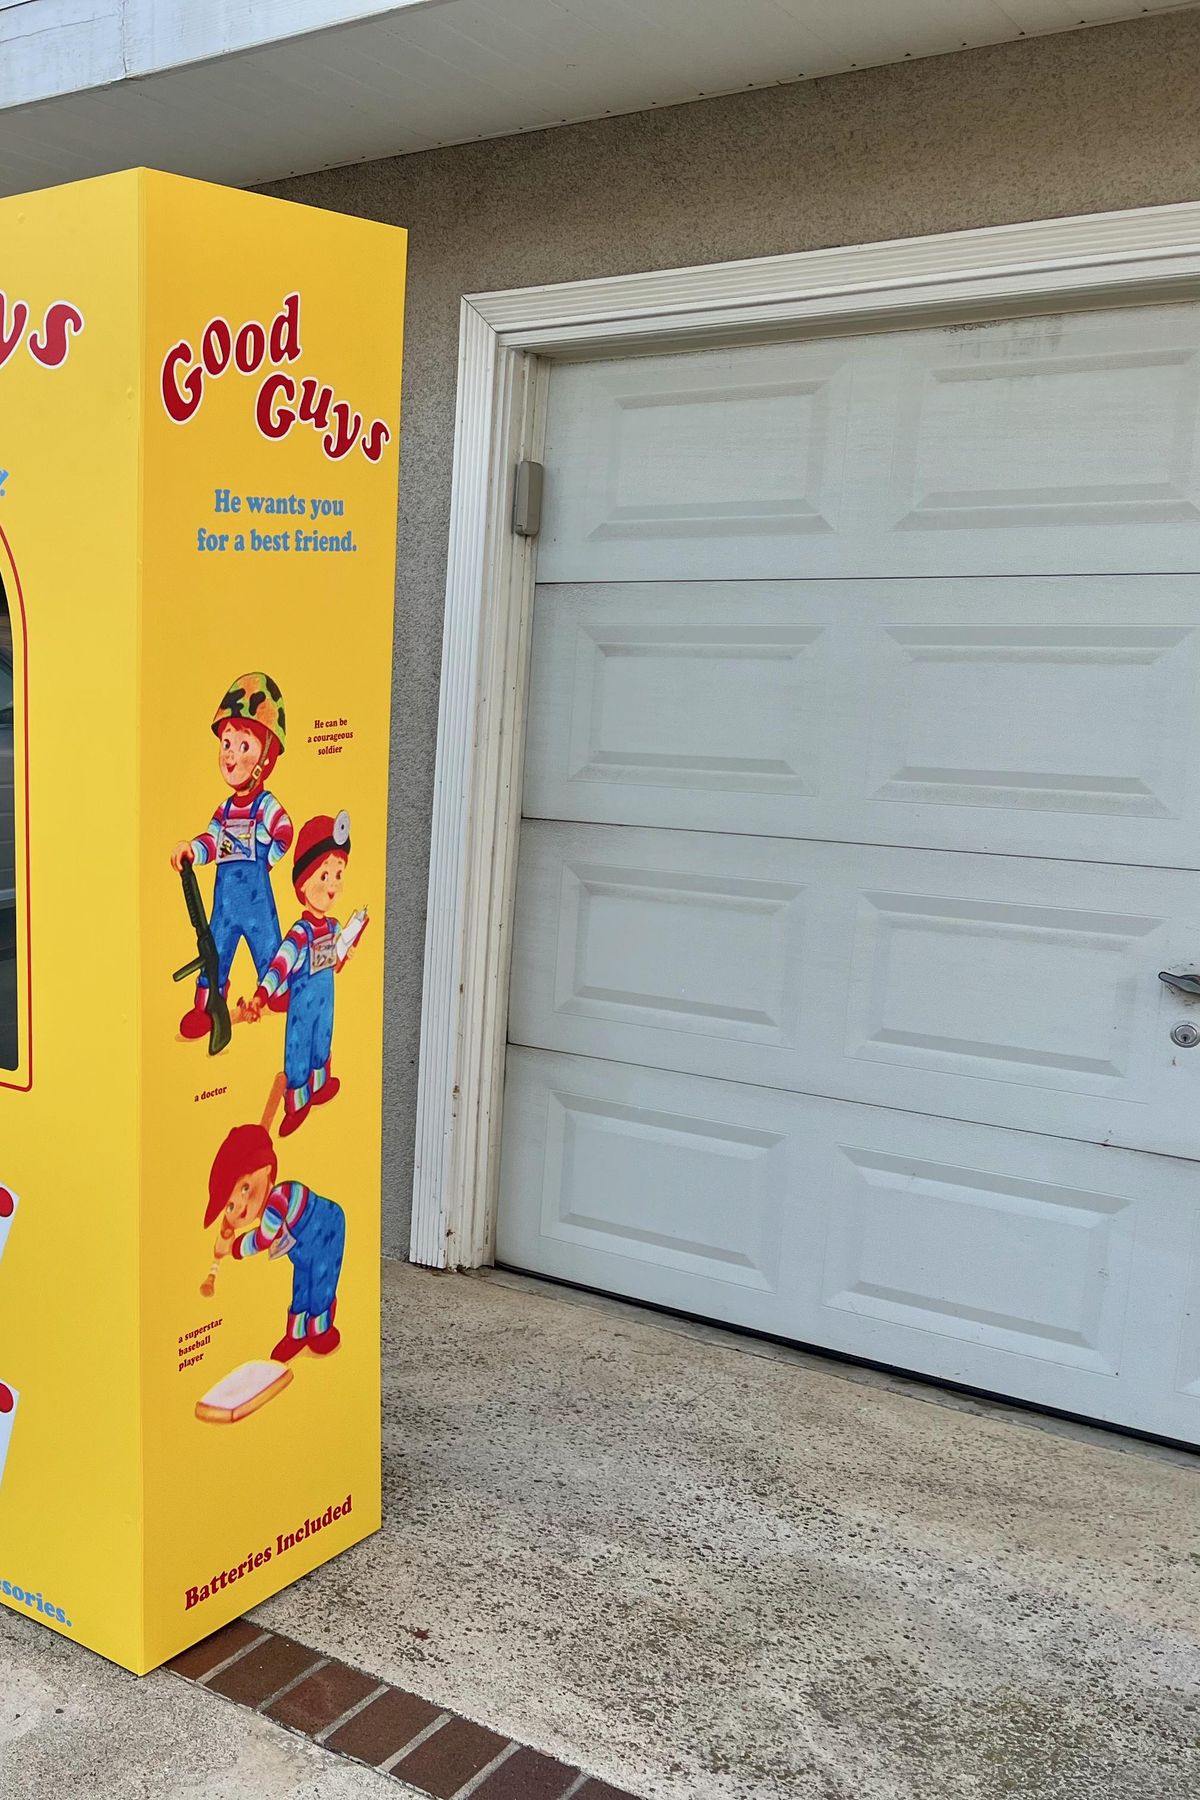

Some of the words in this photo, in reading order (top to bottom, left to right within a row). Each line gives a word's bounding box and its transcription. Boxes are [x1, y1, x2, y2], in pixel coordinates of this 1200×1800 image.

[160, 291, 302, 425] Good
[256, 371, 391, 464] Guys
[214, 489, 241, 513] He
[246, 494, 306, 515] wants
[310, 499, 344, 520] you
[197, 528, 230, 551] for
[234, 535, 245, 551] a
[250, 529, 291, 551] best
[295, 529, 358, 552] friend.
[314, 719, 324, 729] He
[325, 720, 338, 728] can
[339, 717, 348, 726] be
[313, 732, 353, 742] courageous
[318, 745, 342, 755] soldier
[201, 1086, 227, 1100] doctor
[178, 1336, 183, 1344] a
[184, 1318, 223, 1341] superstar
[178, 1334, 211, 1357] baseball
[178, 1353, 204, 1372] player
[184, 1546, 272, 1611] Batteries
[276, 1494, 353, 1556] Included
